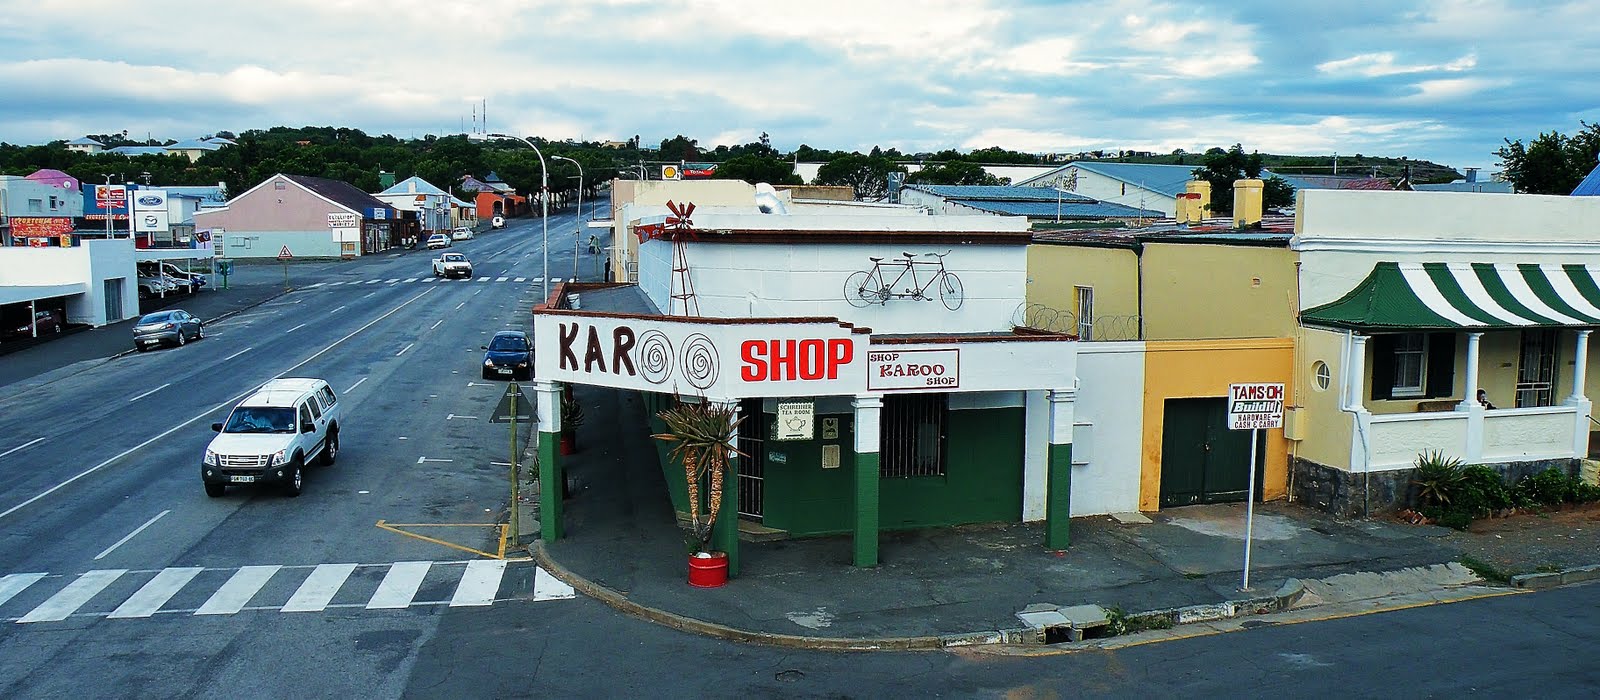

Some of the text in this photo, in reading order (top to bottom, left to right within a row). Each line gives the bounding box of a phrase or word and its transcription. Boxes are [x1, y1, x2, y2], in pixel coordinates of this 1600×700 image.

[741, 339, 854, 382] SHOP
[870, 352, 900, 362] SHOP
[880, 363, 945, 377] KAROO
[926, 376, 956, 386] SHOP
[1234, 420, 1279, 429] CASH & CARRY
